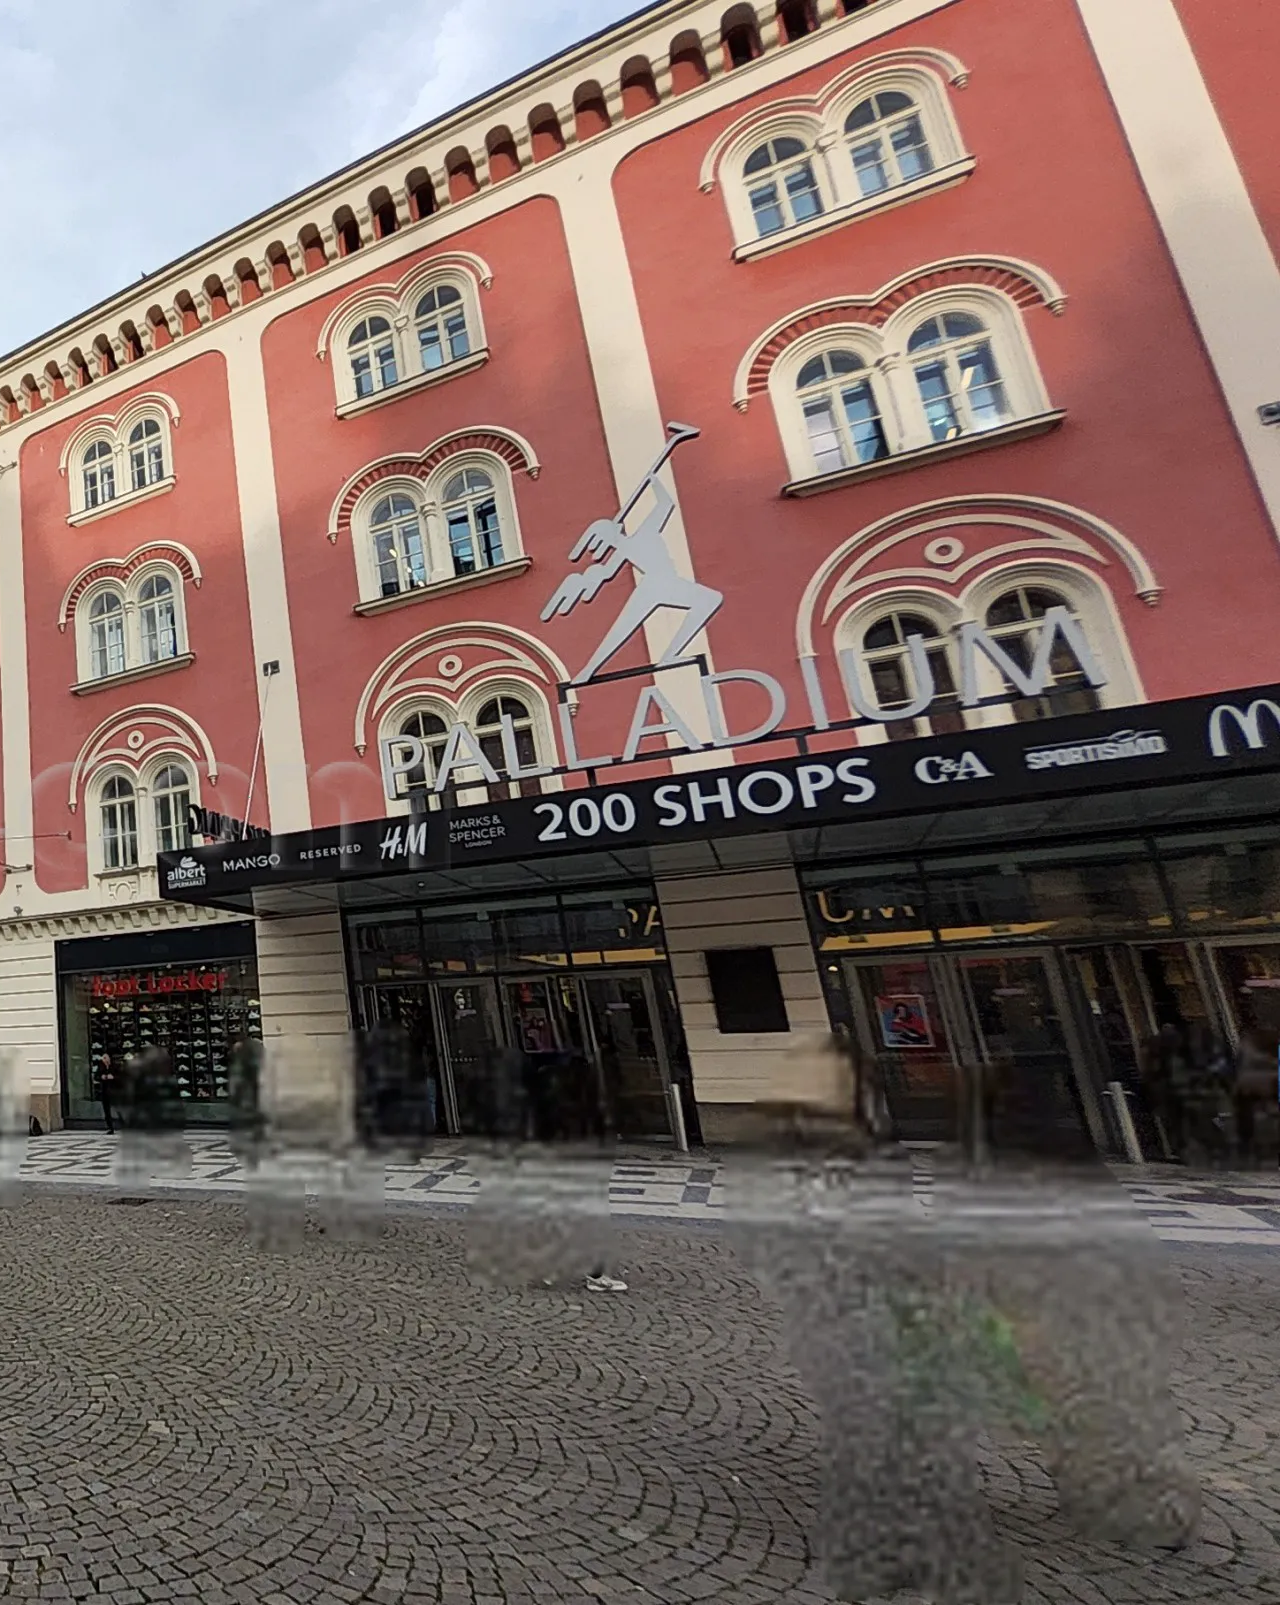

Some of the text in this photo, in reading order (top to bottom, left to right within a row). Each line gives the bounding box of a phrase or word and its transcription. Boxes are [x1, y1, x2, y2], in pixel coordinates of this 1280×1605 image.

[380, 604, 1110, 800] PALLADIUM
[914, 751, 994, 786] C&A
[535, 756, 877, 842] 200 SHOPS
[449, 814, 501, 830] MARKS &
[379, 821, 428, 860] H&M
[449, 826, 506, 844] SPENCER
[465, 840, 493, 848] LONDON
[299, 843, 362, 860] RESERVED
[166, 863, 206, 882] albert
[222, 853, 281, 873] MANGO
